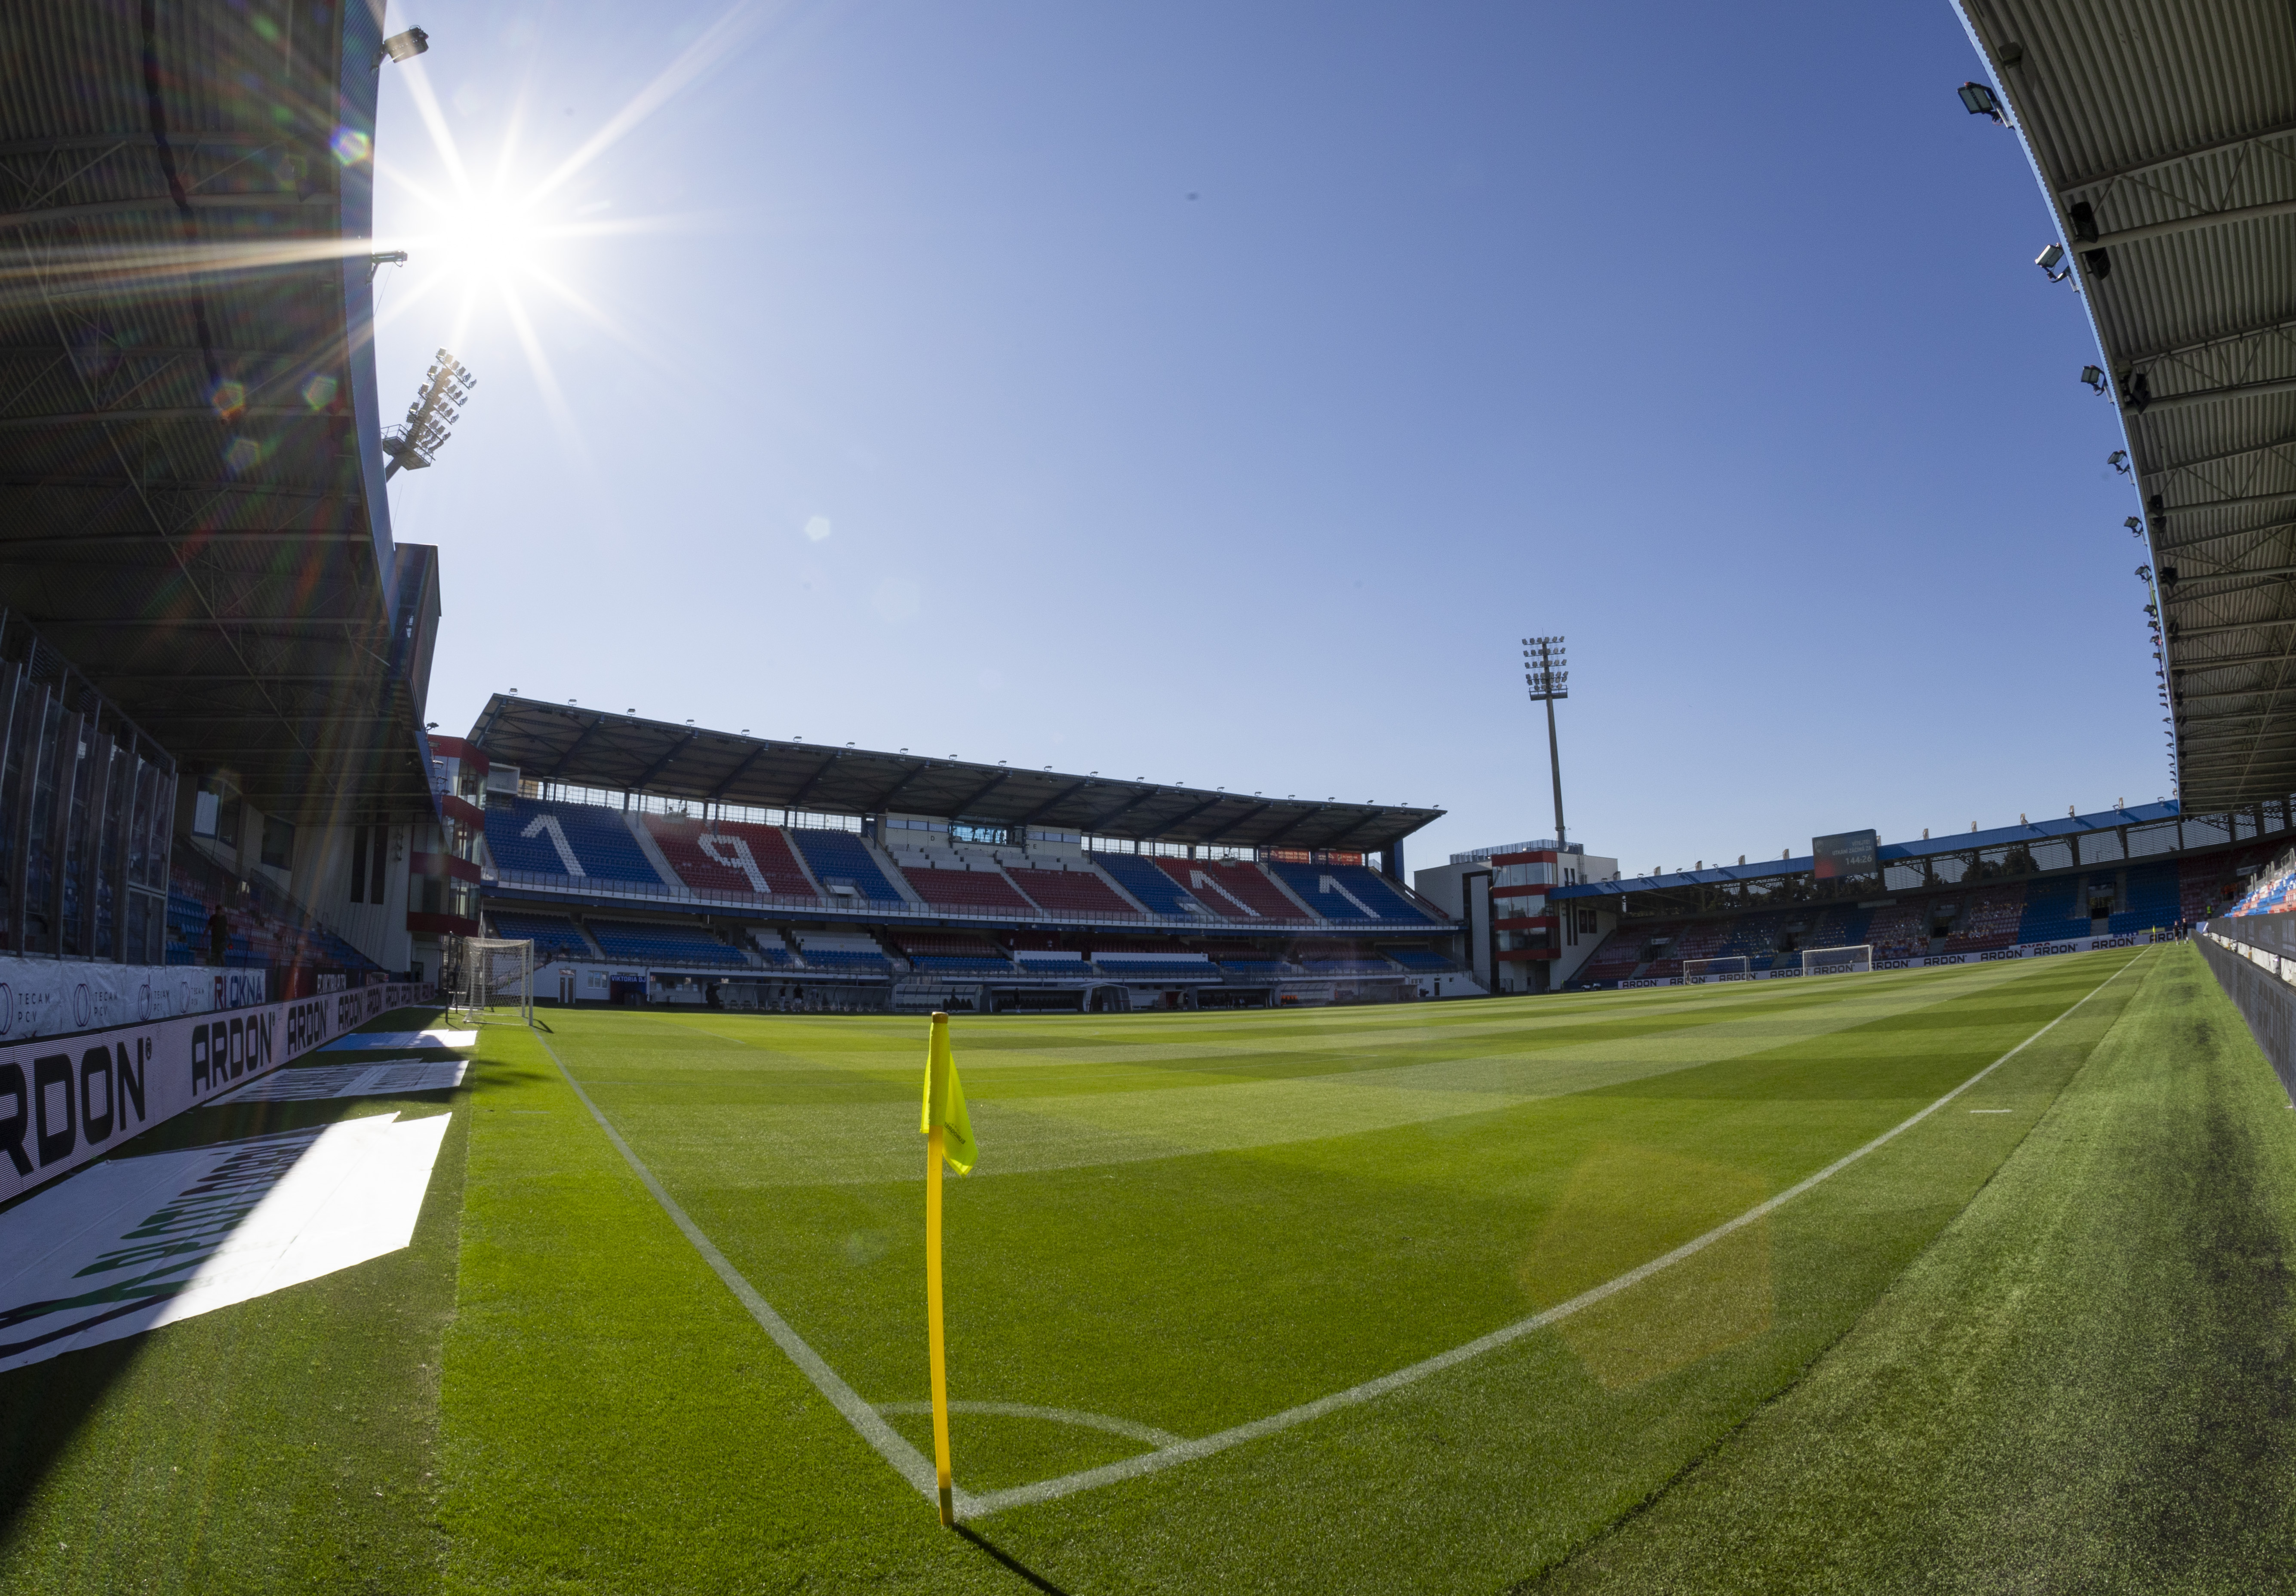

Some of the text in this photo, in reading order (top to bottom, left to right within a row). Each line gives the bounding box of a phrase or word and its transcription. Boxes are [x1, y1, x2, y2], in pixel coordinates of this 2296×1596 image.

[1846, 855, 1872, 865] 144:26
[2150, 929, 2187, 943] ARD
[2092, 937, 2133, 950] ARDON
[1981, 950, 2022, 961] ARDON
[2034, 944, 2076, 956] ARDON
[1872, 960, 1909, 971] ARDON
[1924, 955, 1965, 966] ARDON
[1814, 965, 1853, 975] ARDON
[1623, 980, 1657, 988] ARDON
[1670, 977, 1705, 985] ARON
[215, 975, 262, 1010] RI OKNA
[18, 993, 50, 1005] TECAM
[18, 1011, 37, 1023] PCV
[0, 1036, 152, 1177] RDON®
